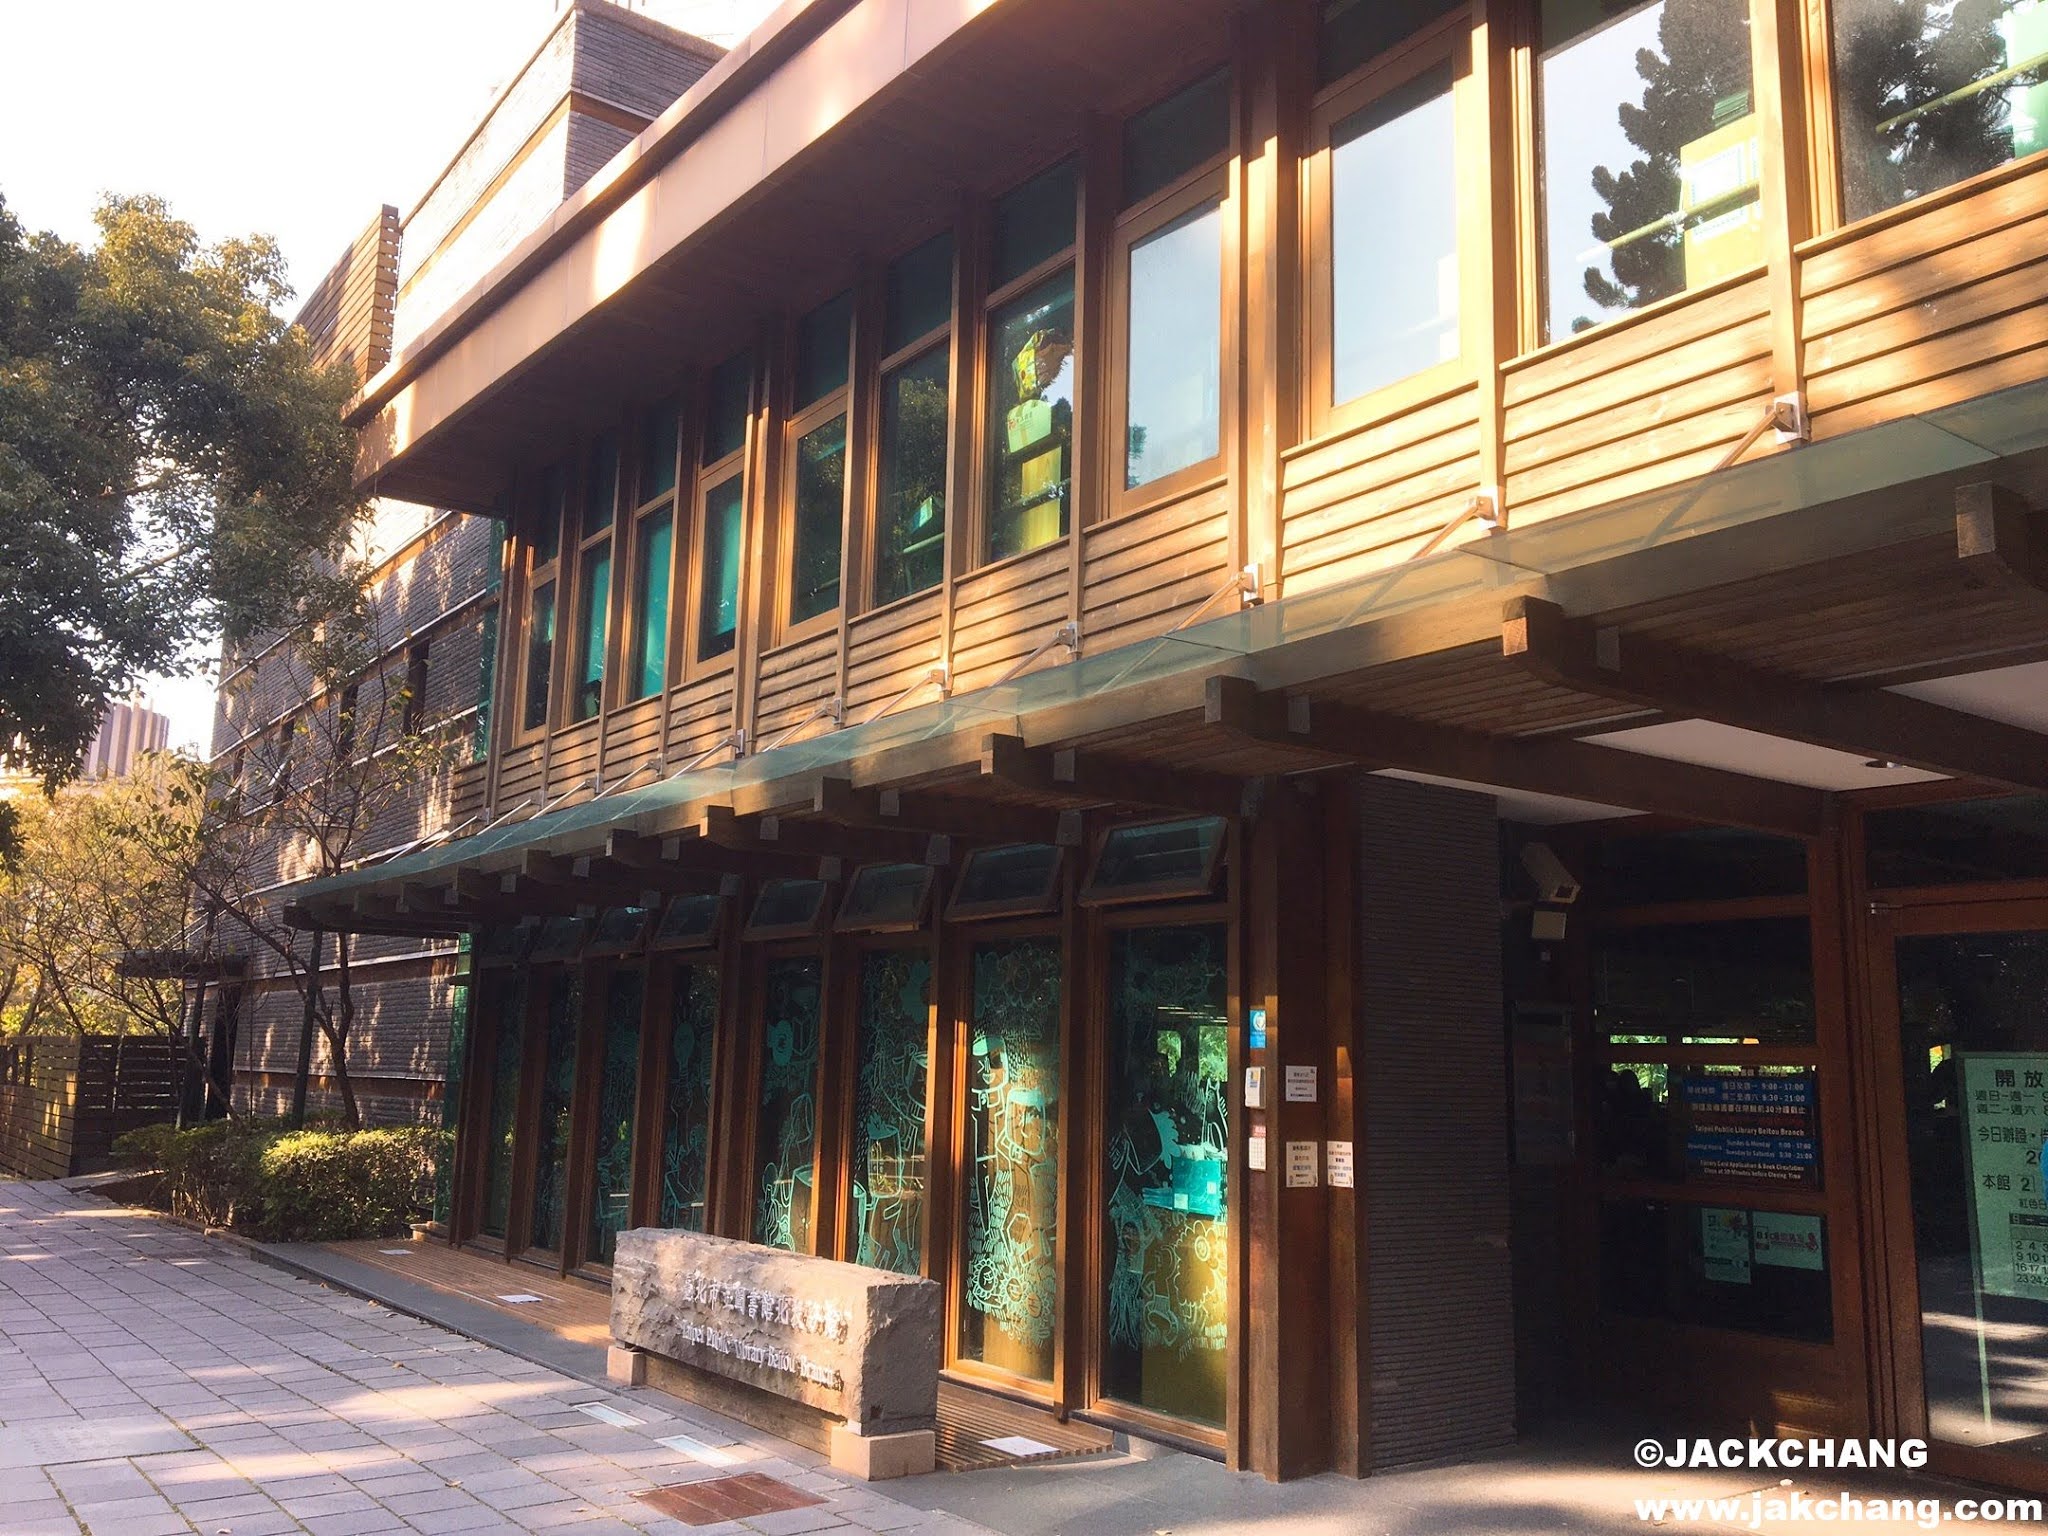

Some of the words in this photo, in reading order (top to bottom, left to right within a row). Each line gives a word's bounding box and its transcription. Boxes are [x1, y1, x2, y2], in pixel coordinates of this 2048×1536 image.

[1695, 1124, 1714, 1134] Taipei
[1714, 1125, 1734, 1134] Public
[1735, 1126, 1757, 1136] Library
[1758, 1127, 1780, 1136] Beitou
[1780, 1128, 1805, 1137] Branch
[1982, 1174, 2011, 1191] 本館
[2015, 1240, 2023, 1250] 2
[2016, 1252, 2024, 1261] 9
[2026, 1252, 2040, 1262] 10
[2015, 1262, 2027, 1272] 16
[2029, 1264, 2040, 1273] 17
[2016, 1273, 2029, 1283] 23
[2030, 1274, 2043, 1284] 24
[681, 1318, 705, 1346] Taipei
[706, 1326, 733, 1354] Public
[768, 1345, 797, 1373] Beitou
